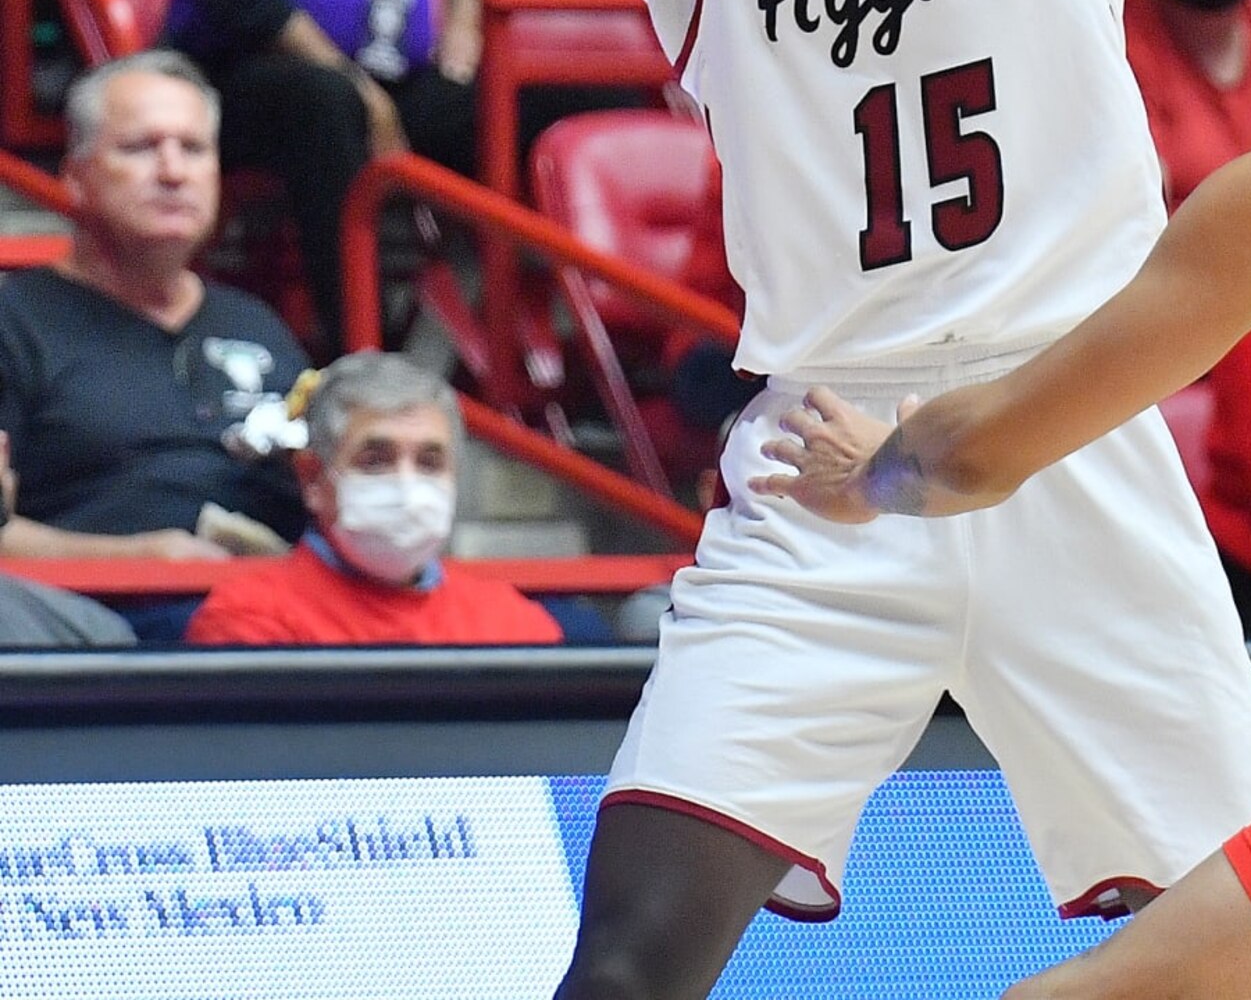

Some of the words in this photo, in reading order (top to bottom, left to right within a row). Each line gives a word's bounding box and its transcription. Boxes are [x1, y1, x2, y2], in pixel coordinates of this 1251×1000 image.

[853, 56, 1005, 272] 15
[21, 892, 129, 939] New
[143, 881, 327, 935] Mexico
